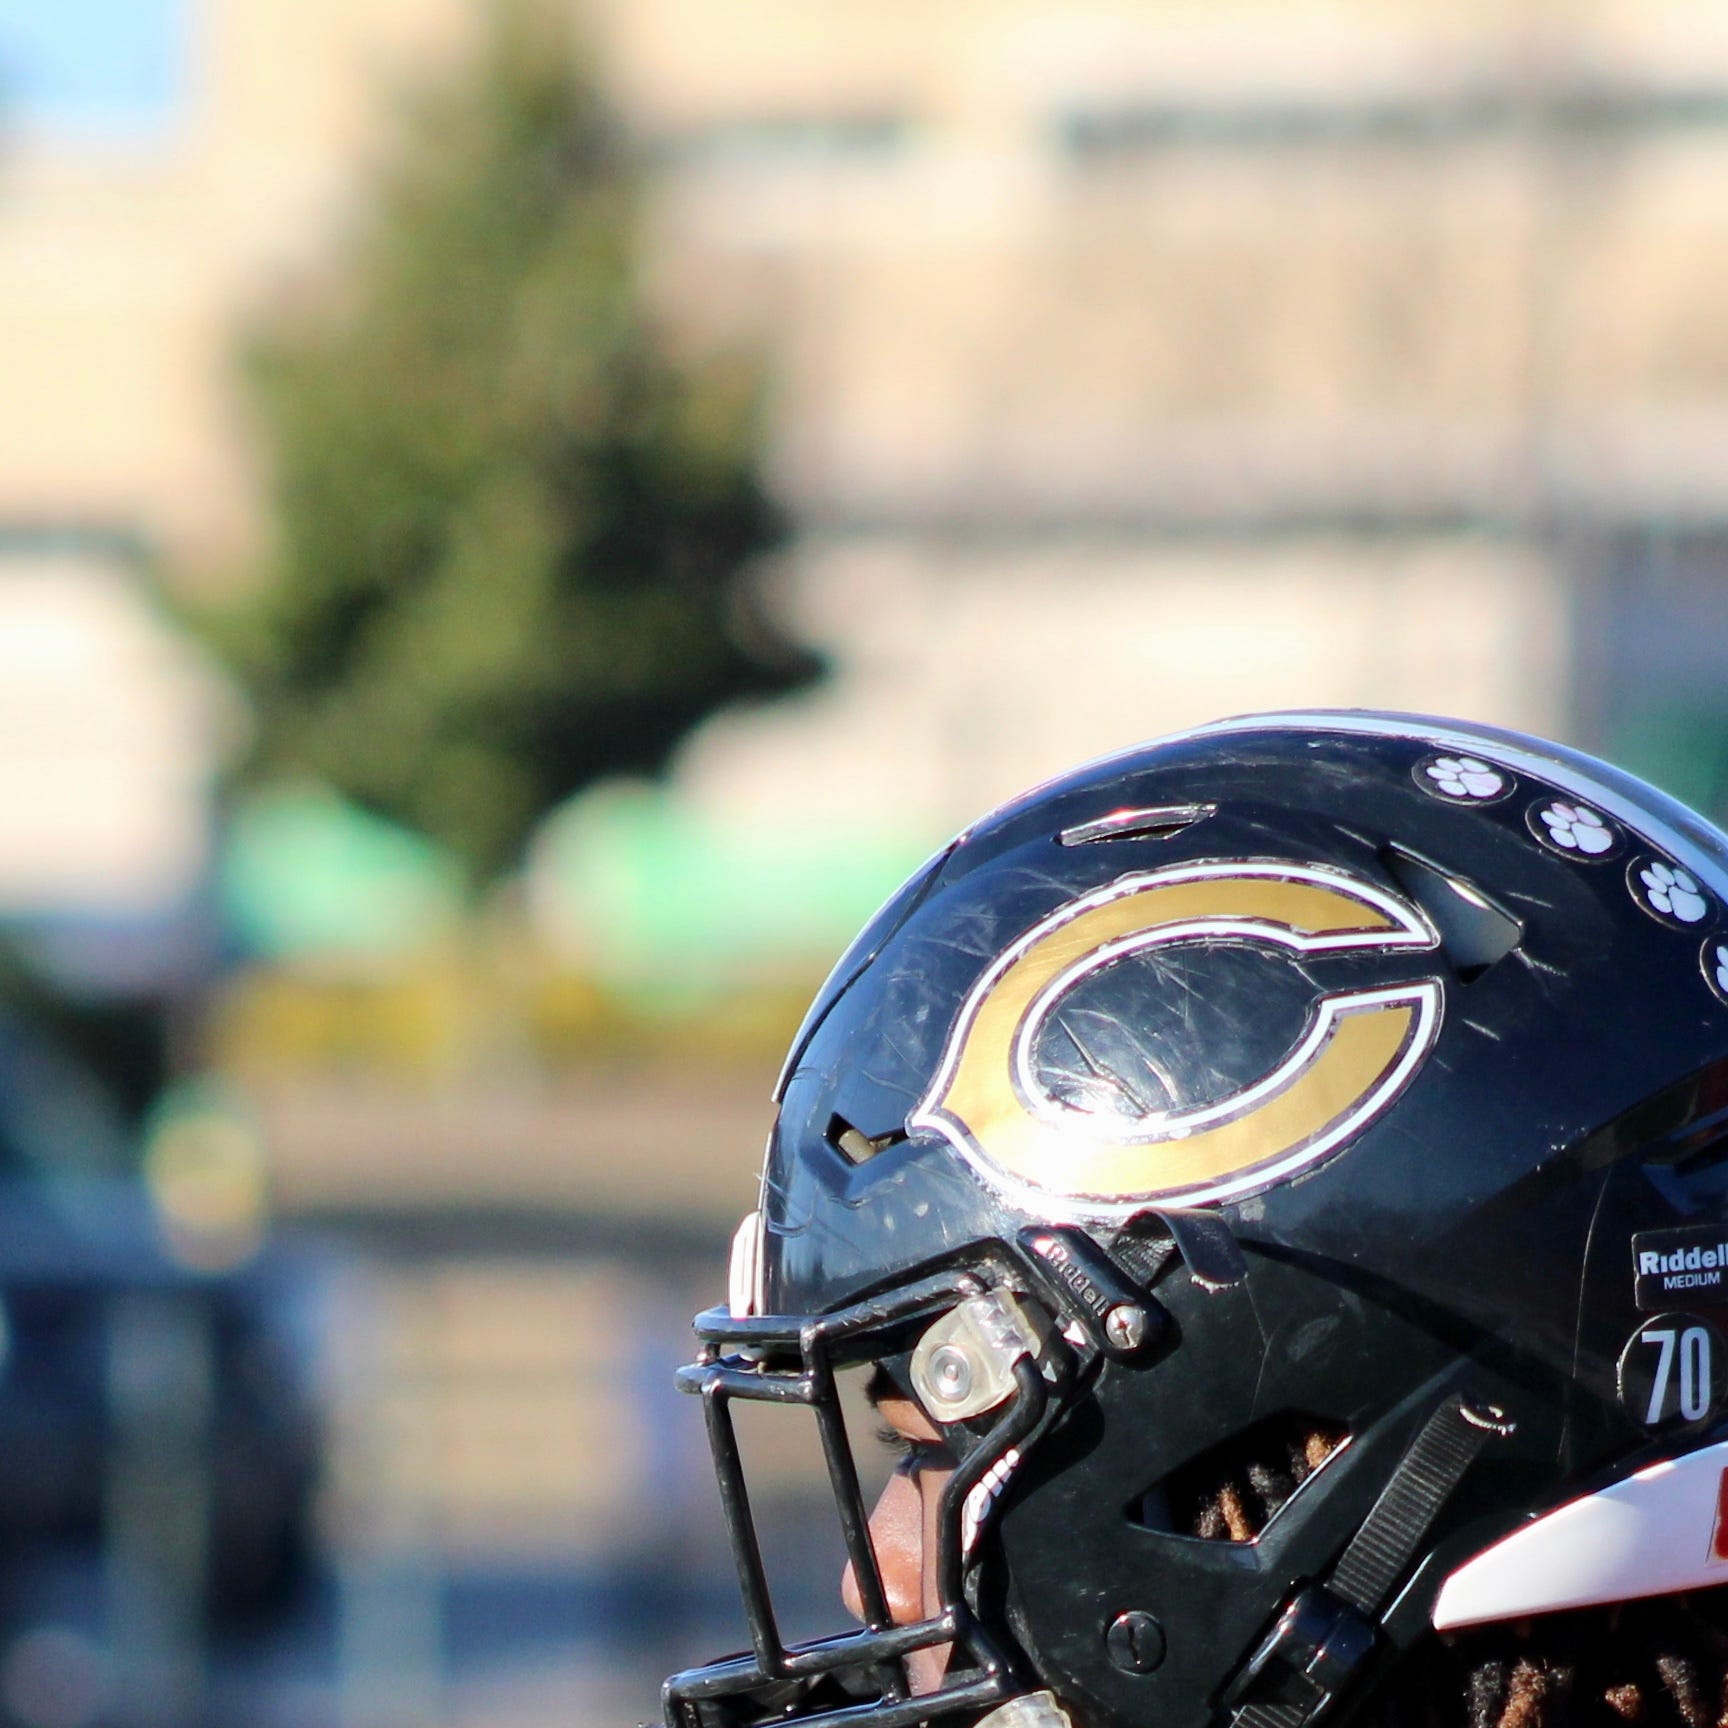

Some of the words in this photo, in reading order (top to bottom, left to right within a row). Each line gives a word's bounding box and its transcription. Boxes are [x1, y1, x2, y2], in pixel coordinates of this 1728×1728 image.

[905, 855, 1444, 1228] C
[1045, 1244, 1110, 1317] Riddell
[1663, 1271, 1721, 1290] MEDIUM
[1641, 1326, 1712, 1425] 70
